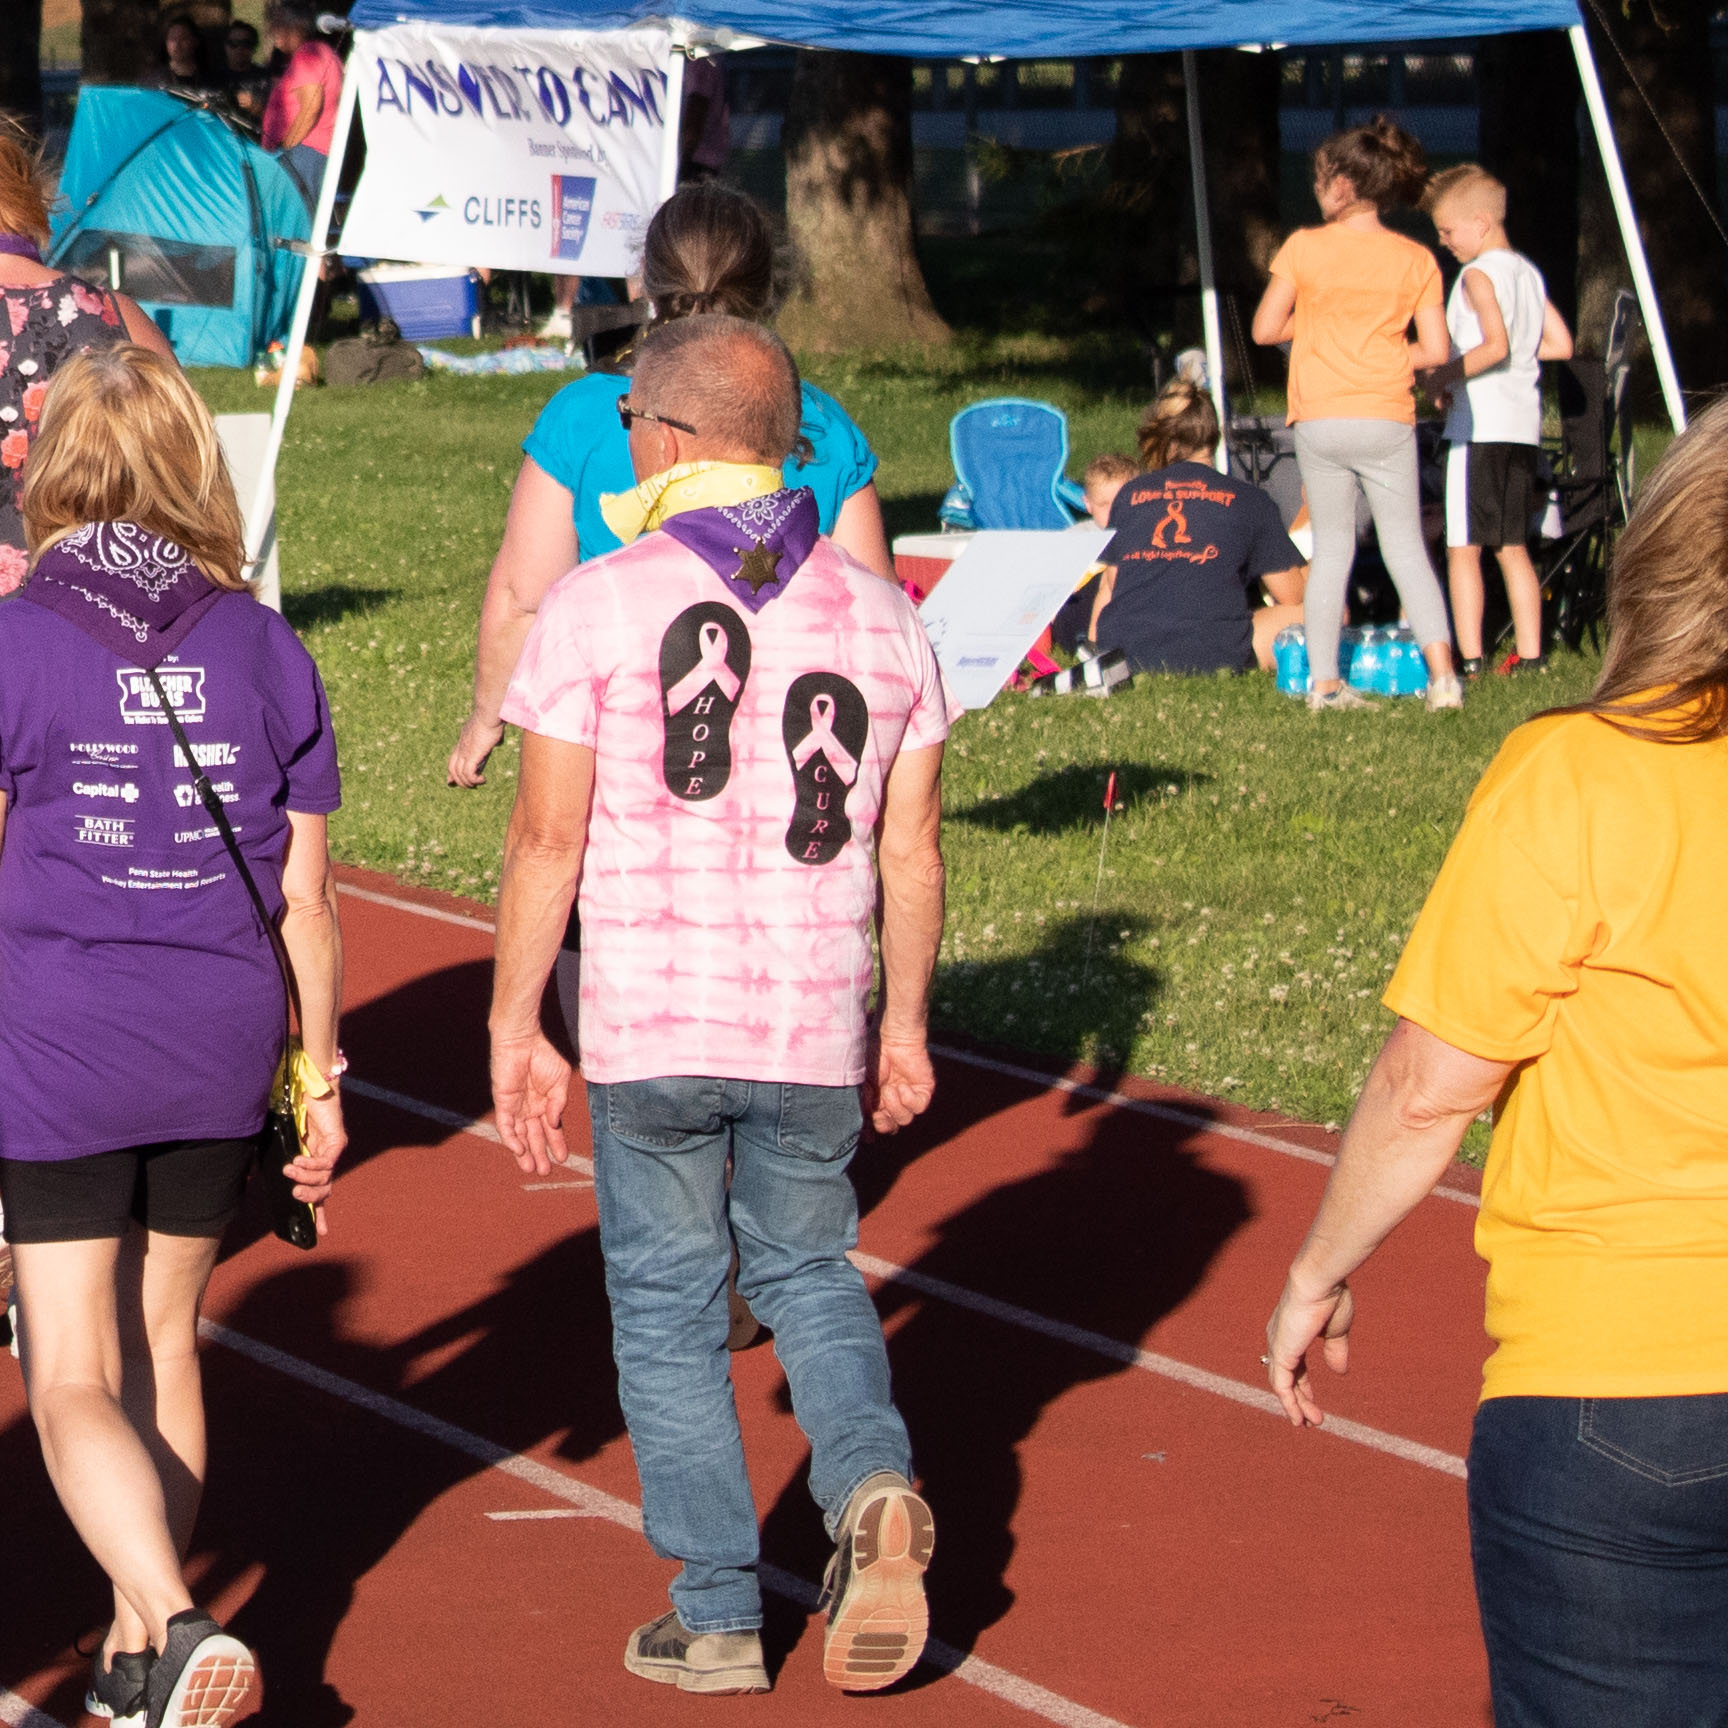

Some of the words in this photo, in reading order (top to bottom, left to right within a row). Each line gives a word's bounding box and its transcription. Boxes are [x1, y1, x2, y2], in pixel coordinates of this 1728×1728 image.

[463, 195, 542, 230] CLIFFS
[129, 675, 193, 695] BLECHER
[69, 742, 140, 755] HOLLYWOOD
[684, 696, 715, 795] HOPE
[72, 781, 120, 799] Capital
[211, 780, 235, 793] ealth
[801, 764, 830, 860] CURE
[84, 817, 125, 832] BATH
[128, 866, 149, 877] Penn
[149, 869, 171, 878] State
[171, 869, 199, 878] Health
[184, 879, 200, 889] and
